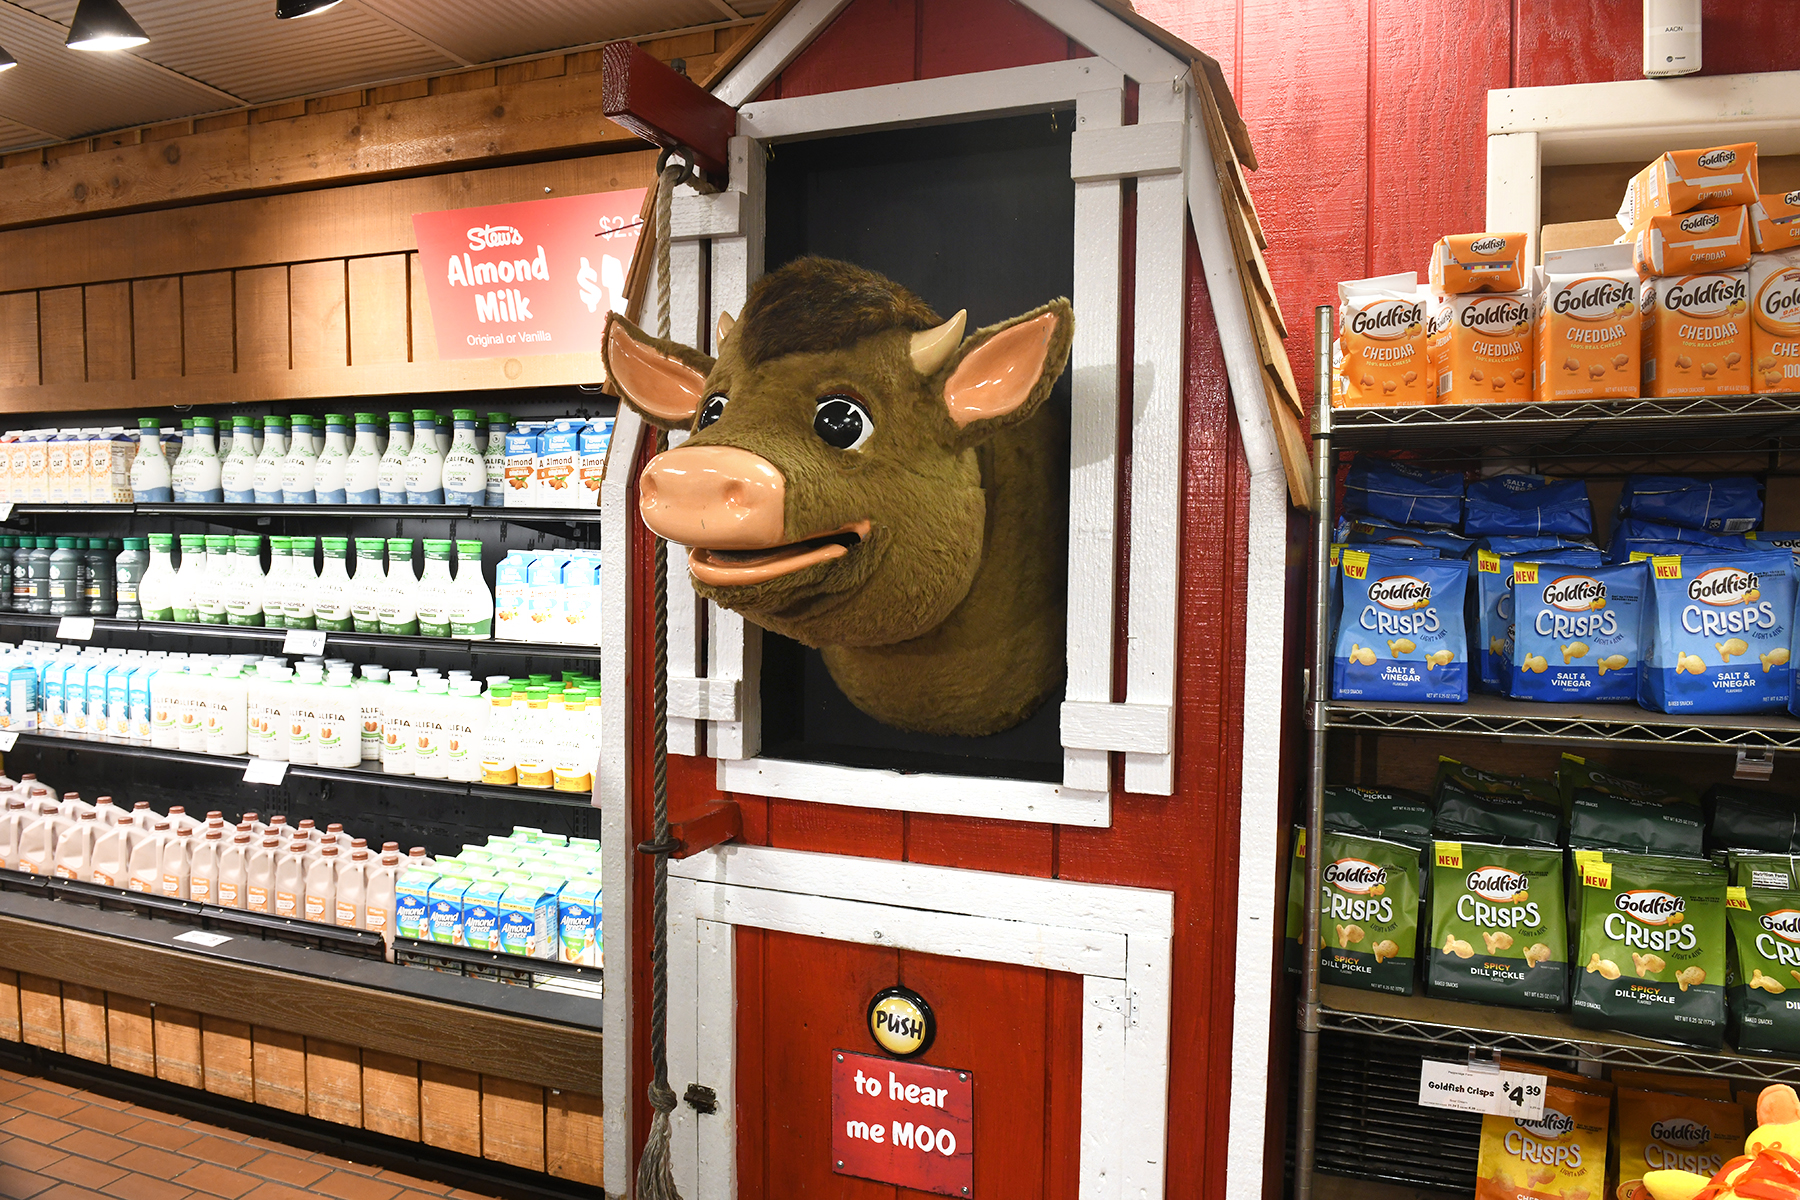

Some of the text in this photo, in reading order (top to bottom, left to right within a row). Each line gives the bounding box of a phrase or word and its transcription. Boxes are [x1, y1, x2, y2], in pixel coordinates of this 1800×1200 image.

[1697, 149, 1736, 167] Goldfish
[1680, 213, 1719, 232] Goldfish
[467, 224, 524, 251] Stew's
[1471, 238, 1506, 253] Goldfish
[1690, 250, 1726, 263] CHEDDAR
[447, 245, 550, 287] Almond
[1553, 282, 1633, 314] Goldfish
[1665, 279, 1745, 310] Goldfish
[475, 288, 533, 323] Milk
[1352, 303, 1422, 334] Goldfish
[1461, 302, 1529, 327] Goldfish
[467, 330, 552, 347] Original or Vanilla
[1566, 324, 1626, 343] CHEDDAR
[1678, 322, 1739, 341] CHEDDAR
[1363, 343, 1416, 361] CHEDDAR
[1472, 340, 1523, 357] CHEDDAR
[1771, 342, 1800, 357] CHE
[1783, 364, 1800, 378] 100
[506, 457, 533, 467] Almond
[546, 455, 573, 466] Almond
[1506, 478, 1526, 487] SALT
[1345, 565, 1365, 578] NEW
[1480, 562, 1498, 572] NEW
[1657, 566, 1678, 577] NEW
[1516, 571, 1536, 582] NEW
[1368, 582, 1431, 600] Goldfish
[1543, 581, 1607, 604] Goldfish
[1689, 573, 1758, 600] Goldfish
[1360, 605, 1440, 635] CRISPS
[1535, 610, 1618, 638] CRISPS
[1682, 601, 1776, 637] CRISPS
[1380, 673, 1421, 682] VINEGAR
[1386, 666, 1408, 674] SALT
[1556, 672, 1578, 680] SALT
[1717, 672, 1750, 680] SALT &
[1551, 679, 1591, 687] VINEGAR
[1712, 679, 1756, 688] VINEGAR
[1439, 855, 1460, 866] NEW
[1323, 864, 1387, 885] Goldfish
[1467, 871, 1529, 891] Goldfish
[1585, 875, 1608, 887] NEW
[397, 905, 425, 916] Almond
[1321, 886, 1393, 922] CRISPS
[1457, 894, 1541, 928] CRISPS
[1615, 893, 1686, 913] Goldfish
[1726, 899, 1747, 908] NEW
[430, 911, 459, 923] Almond
[465, 917, 496, 928] Almond
[560, 915, 591, 926] Almond
[501, 922, 532, 933] Almond
[1604, 913, 1697, 952] CRISPS
[1321, 959, 1372, 974] DILL PICKLE
[1334, 955, 1360, 965] SPICY
[1483, 962, 1511, 971] SPICY
[1470, 967, 1525, 980] DILL PICKLE
[1615, 989, 1676, 1004] DILL PICKLE
[1630, 984, 1661, 994] SPICY
[875, 1010, 923, 1040] PUSH
[853, 1069, 948, 1108] to hear
[1428, 1081, 1495, 1098] Goldfish Crisps
[846, 1120, 957, 1156] me MOO
[1650, 1121, 1711, 1142] Goldfish
[1504, 1130, 1582, 1168] CRISPS
[1644, 1143, 1722, 1177] CRISPS
